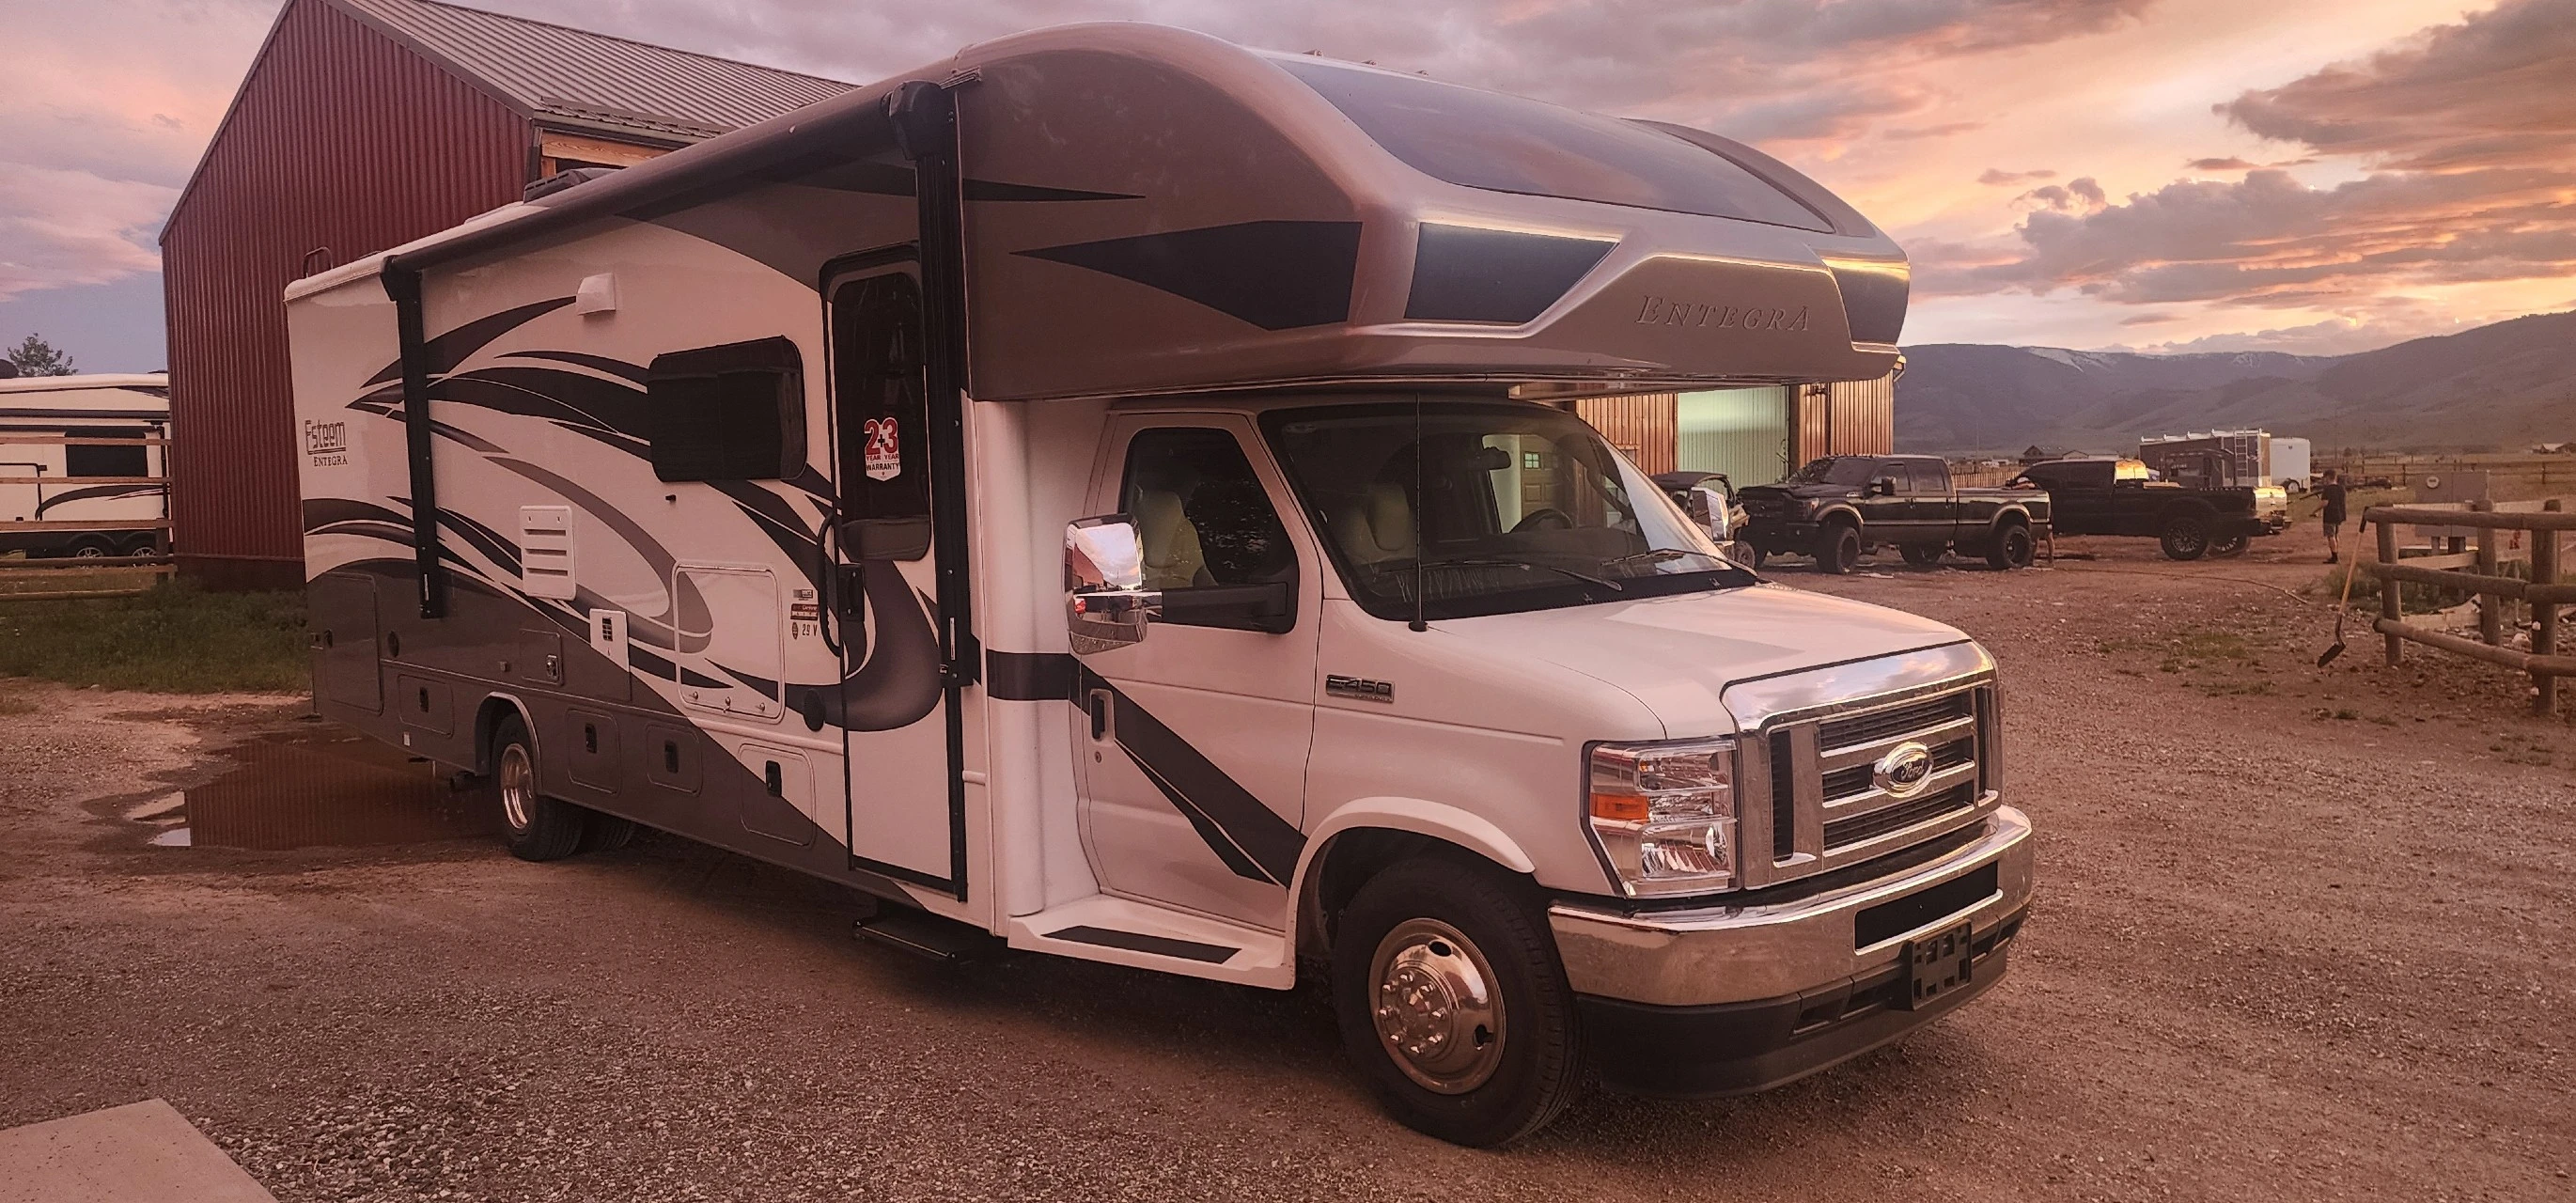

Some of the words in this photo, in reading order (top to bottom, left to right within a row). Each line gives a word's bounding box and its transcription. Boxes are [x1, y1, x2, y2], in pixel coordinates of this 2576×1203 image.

[304, 419, 347, 455] Esteem
[313, 456, 348, 467] ENTEGRA
[866, 462, 899, 471] WARRANTY
[1900, 759, 1925, 781] Ford
